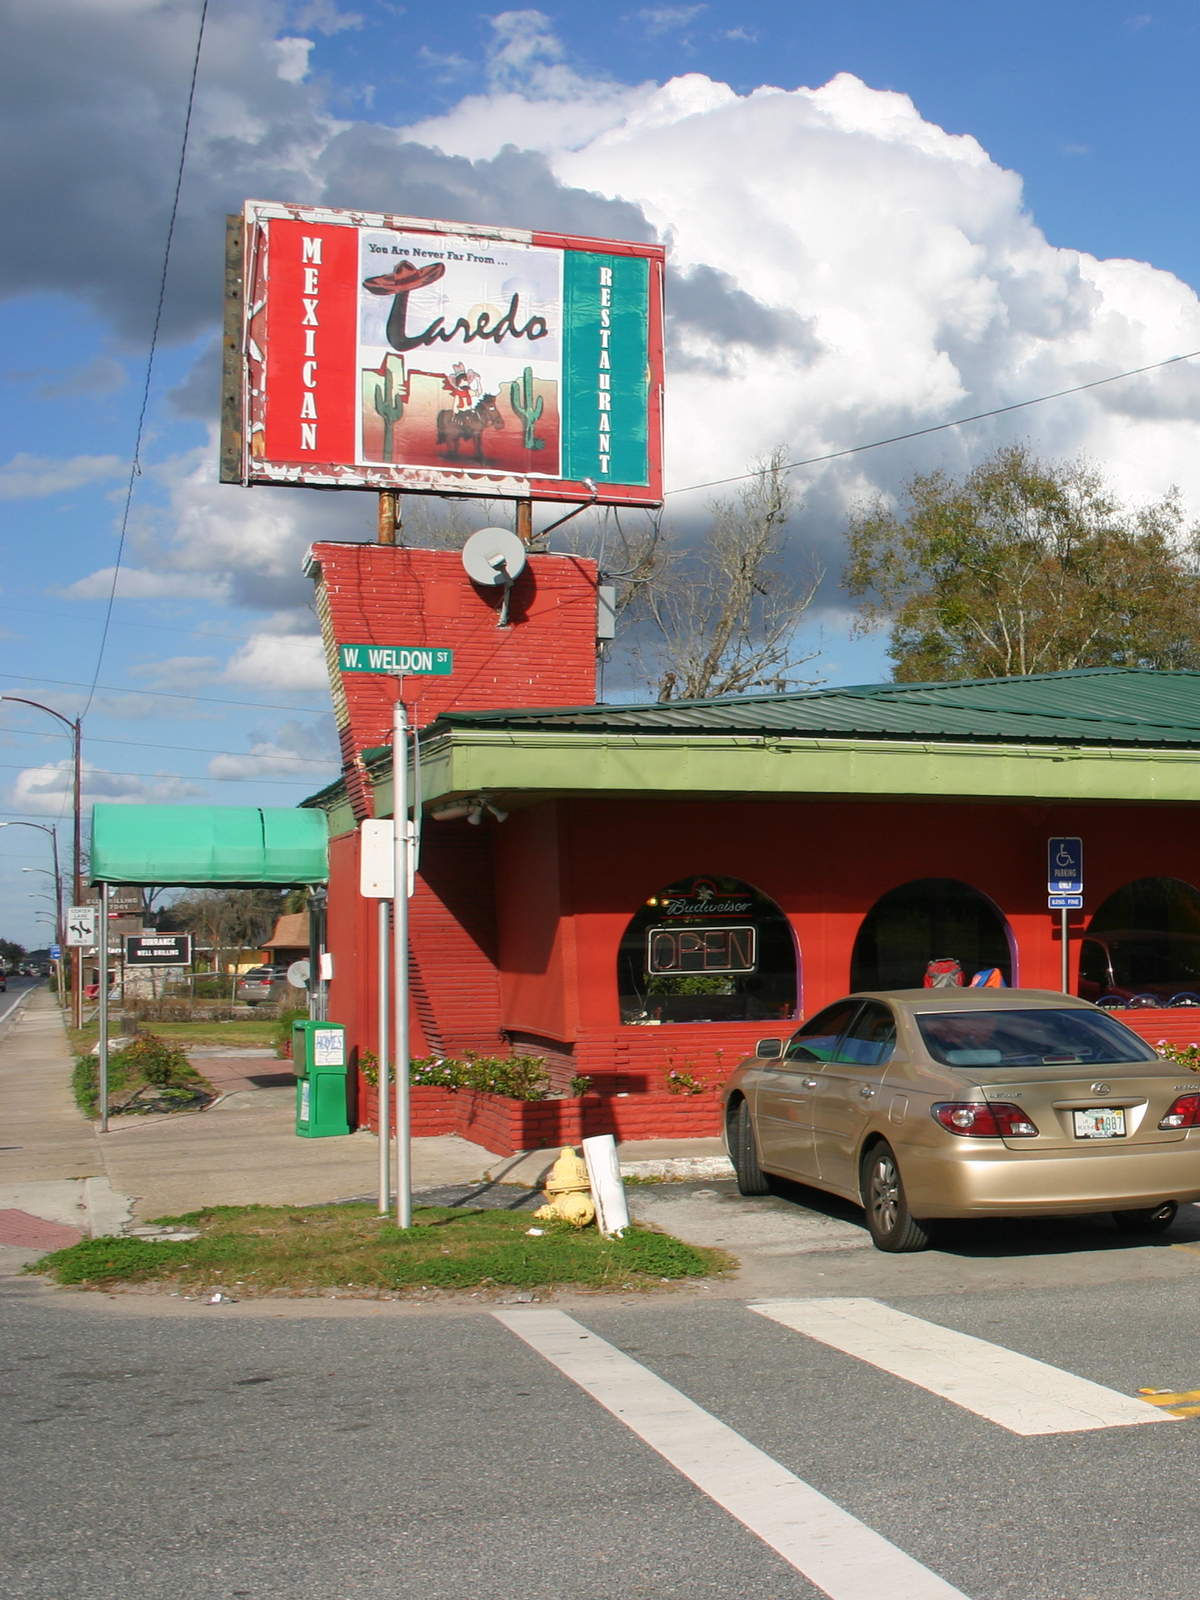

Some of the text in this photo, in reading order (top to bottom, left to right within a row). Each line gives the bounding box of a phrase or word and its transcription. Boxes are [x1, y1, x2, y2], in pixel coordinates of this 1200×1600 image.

[368, 243, 388, 253] You
[391, 245, 410, 256] Are
[413, 248, 445, 259] Never
[447, 251, 464, 261] Far
[467, 253, 495, 264] From
[300, 236, 322, 451] MEXICAN
[598, 266, 613, 474] RESTAURANT
[344, 648, 449, 671] W. WELDON ST
[1054, 868, 1077, 877] PARKING
[1058, 880, 1072, 889] ONLY
[661, 898, 753, 915] Budweiser
[653, 930, 751, 970] OPEN
